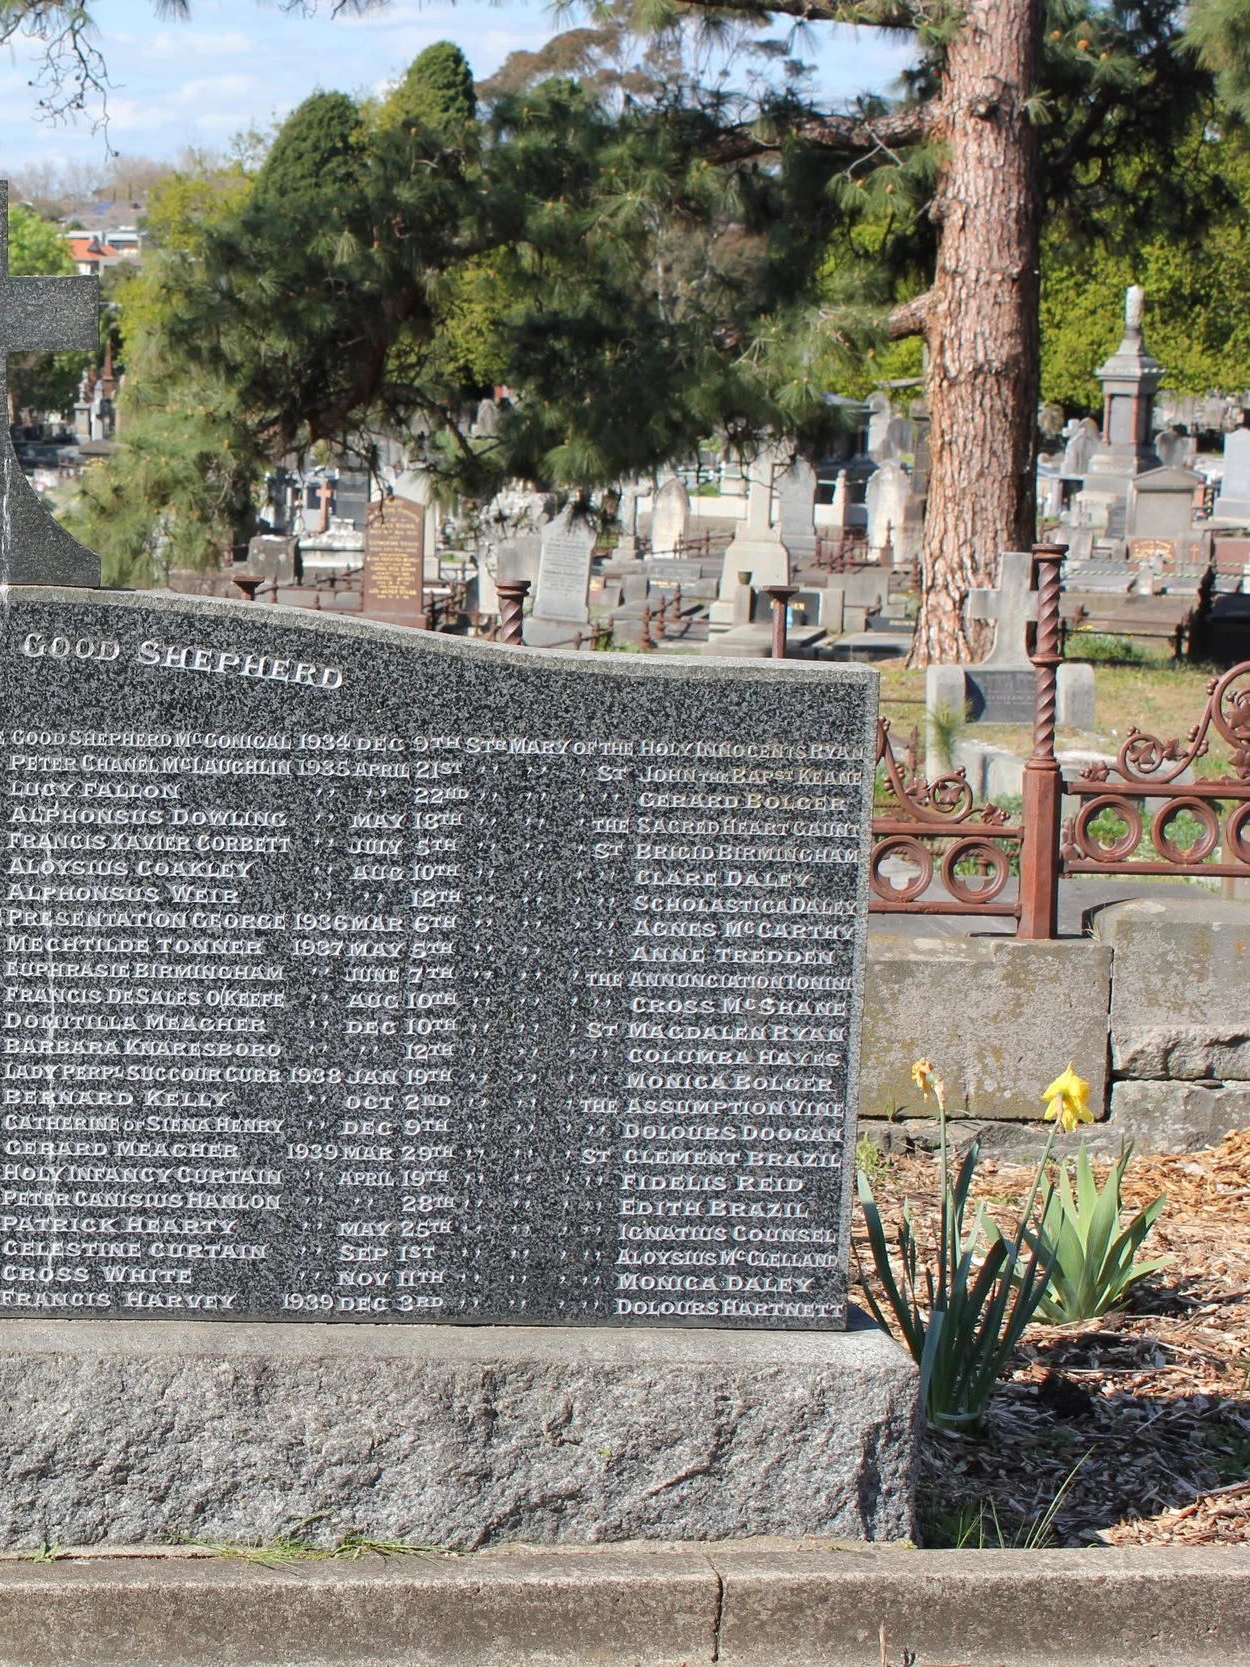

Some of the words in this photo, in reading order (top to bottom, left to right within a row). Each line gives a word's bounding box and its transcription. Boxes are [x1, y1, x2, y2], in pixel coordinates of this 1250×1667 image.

[23, 632, 120, 662] GOOD
[139, 641, 344, 689] SHEPHERD
[11, 730, 65, 745] GOOD
[69, 730, 171, 747] SHEPHERD
[299, 732, 350, 749] 1934
[354, 737, 404, 751] DEC
[638, 740, 694, 757] HOLY
[696, 742, 807, 758] INNOCENTS
[808, 744, 865, 760] RYAN
[7, 754, 79, 771] PETER
[300, 761, 350, 777] 1935
[8, 782, 77, 797] LUCY
[80, 782, 181, 799] FALLON
[639, 793, 739, 807] GERARD
[744, 793, 848, 811] BOLGER
[8, 806, 163, 823] ALPHONSUS
[170, 808, 287, 826] DOWLING
[636, 818, 719, 834] SACRED
[721, 819, 791, 835] HEART
[6, 832, 106, 850] FRANCIS
[112, 834, 190, 851] XAVIER
[196, 835, 290, 852] CORBETT
[634, 844, 714, 860] BRIGID
[715, 845, 859, 863] BIRMINGHAM
[6, 858, 128, 875] ALOYSIUS
[136, 860, 255, 877] COAKLEY
[635, 870, 716, 885] CLARE
[724, 871, 813, 887] DALEY
[167, 885, 239, 903] WEIR
[631, 896, 787, 913] SCHOLASTICA
[6, 909, 190, 928] PRESENTATION
[192, 912, 285, 929] GEORGE
[294, 914, 347, 930] 1936
[631, 919, 717, 937] AGNES
[293, 938, 344, 956] 1937
[629, 946, 705, 962] ANNE
[5, 961, 129, 978] EUPHRASIE
[132, 963, 285, 980] BIRMINGHAM
[144, 1014, 267, 1031] MEAGHER
[626, 1022, 768, 1040] MAGDALEN
[3, 1038, 117, 1055] BARBARA
[628, 1048, 751, 1063] COLUMBA
[757, 1050, 841, 1066] HAYES
[4, 1064, 59, 1079] LADY
[124, 1065, 222, 1082] SUCCOUR
[289, 1068, 341, 1083] 1938
[622, 1073, 734, 1089] MONICA
[735, 1074, 835, 1092] BOLGER
[4, 1089, 133, 1105] BERNARD
[143, 1091, 232, 1107] KELLY
[625, 1100, 790, 1115] ASSUMPTION
[5, 1115, 119, 1131] CATHERINE
[215, 1118, 285, 1133] HENRY
[621, 1124, 736, 1139] DOLOURS
[4, 1141, 107, 1156] GERARD
[623, 1151, 744, 1165] CLEMENT
[620, 1175, 726, 1191] FIDELIS
[736, 1176, 804, 1192] REID
[73, 1191, 186, 1207] CANISIUS
[619, 1200, 703, 1215] EDITH
[708, 1201, 809, 1217] BRAZIL
[0, 1216, 121, 1232] PATRICK
[617, 1224, 727, 1240] IGNATIUS
[2, 1240, 140, 1257] CELESTINE
[150, 1241, 268, 1258] CURTAIN
[2, 1265, 89, 1281] CROSS
[100, 1266, 192, 1283] WHITE
[723, 1275, 815, 1292] DALEY
[0, 1288, 111, 1306] FRANCIS
[124, 1291, 238, 1308] HARVEY
[283, 1294, 334, 1310] 1939
[614, 1299, 718, 1316] DOLOURS
[719, 1301, 844, 1318] HARTNETT
